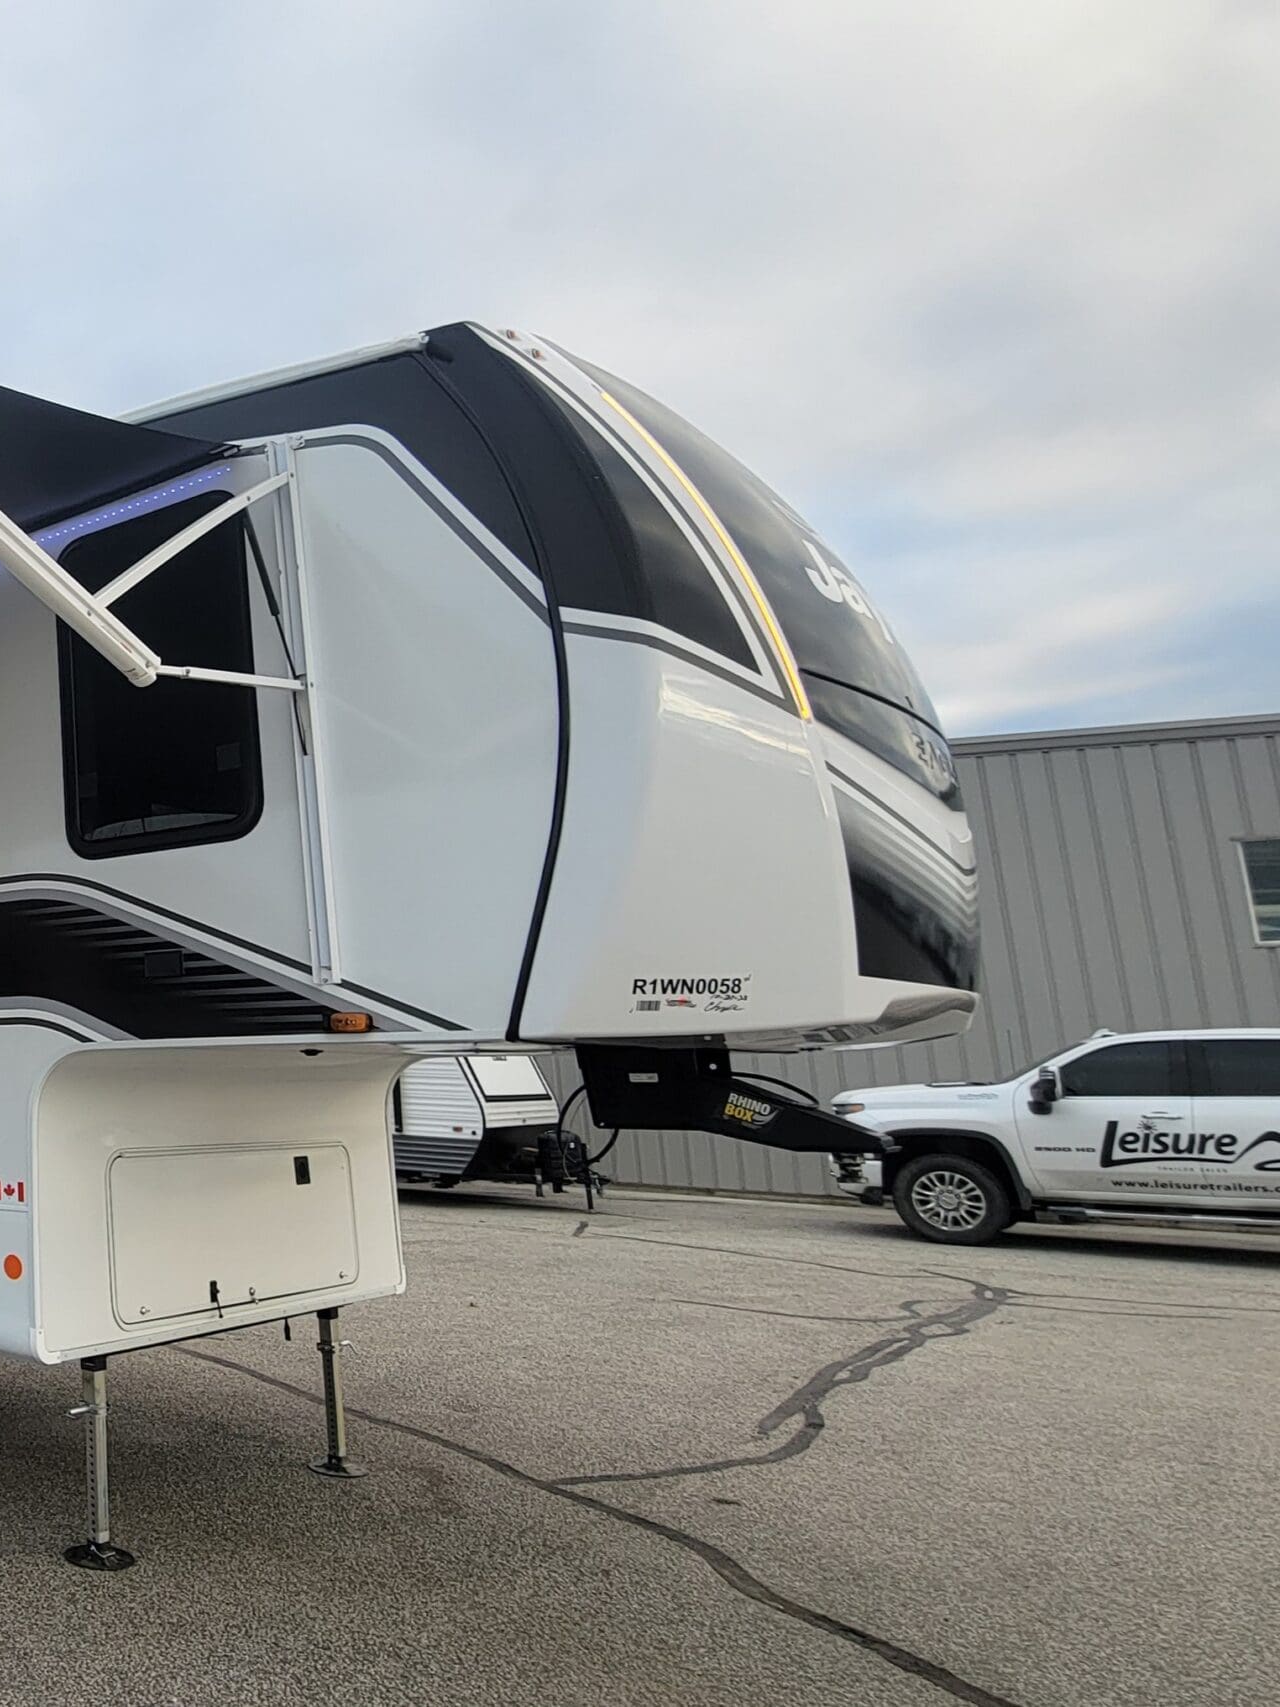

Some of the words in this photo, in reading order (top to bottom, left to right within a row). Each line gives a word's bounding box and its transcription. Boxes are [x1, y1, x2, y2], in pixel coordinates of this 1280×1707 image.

[632, 978, 742, 995] R1WN0058
[724, 1103, 754, 1122] BOX
[728, 1092, 771, 1115] RHINO
[1100, 1120, 1238, 1168] Leisure
